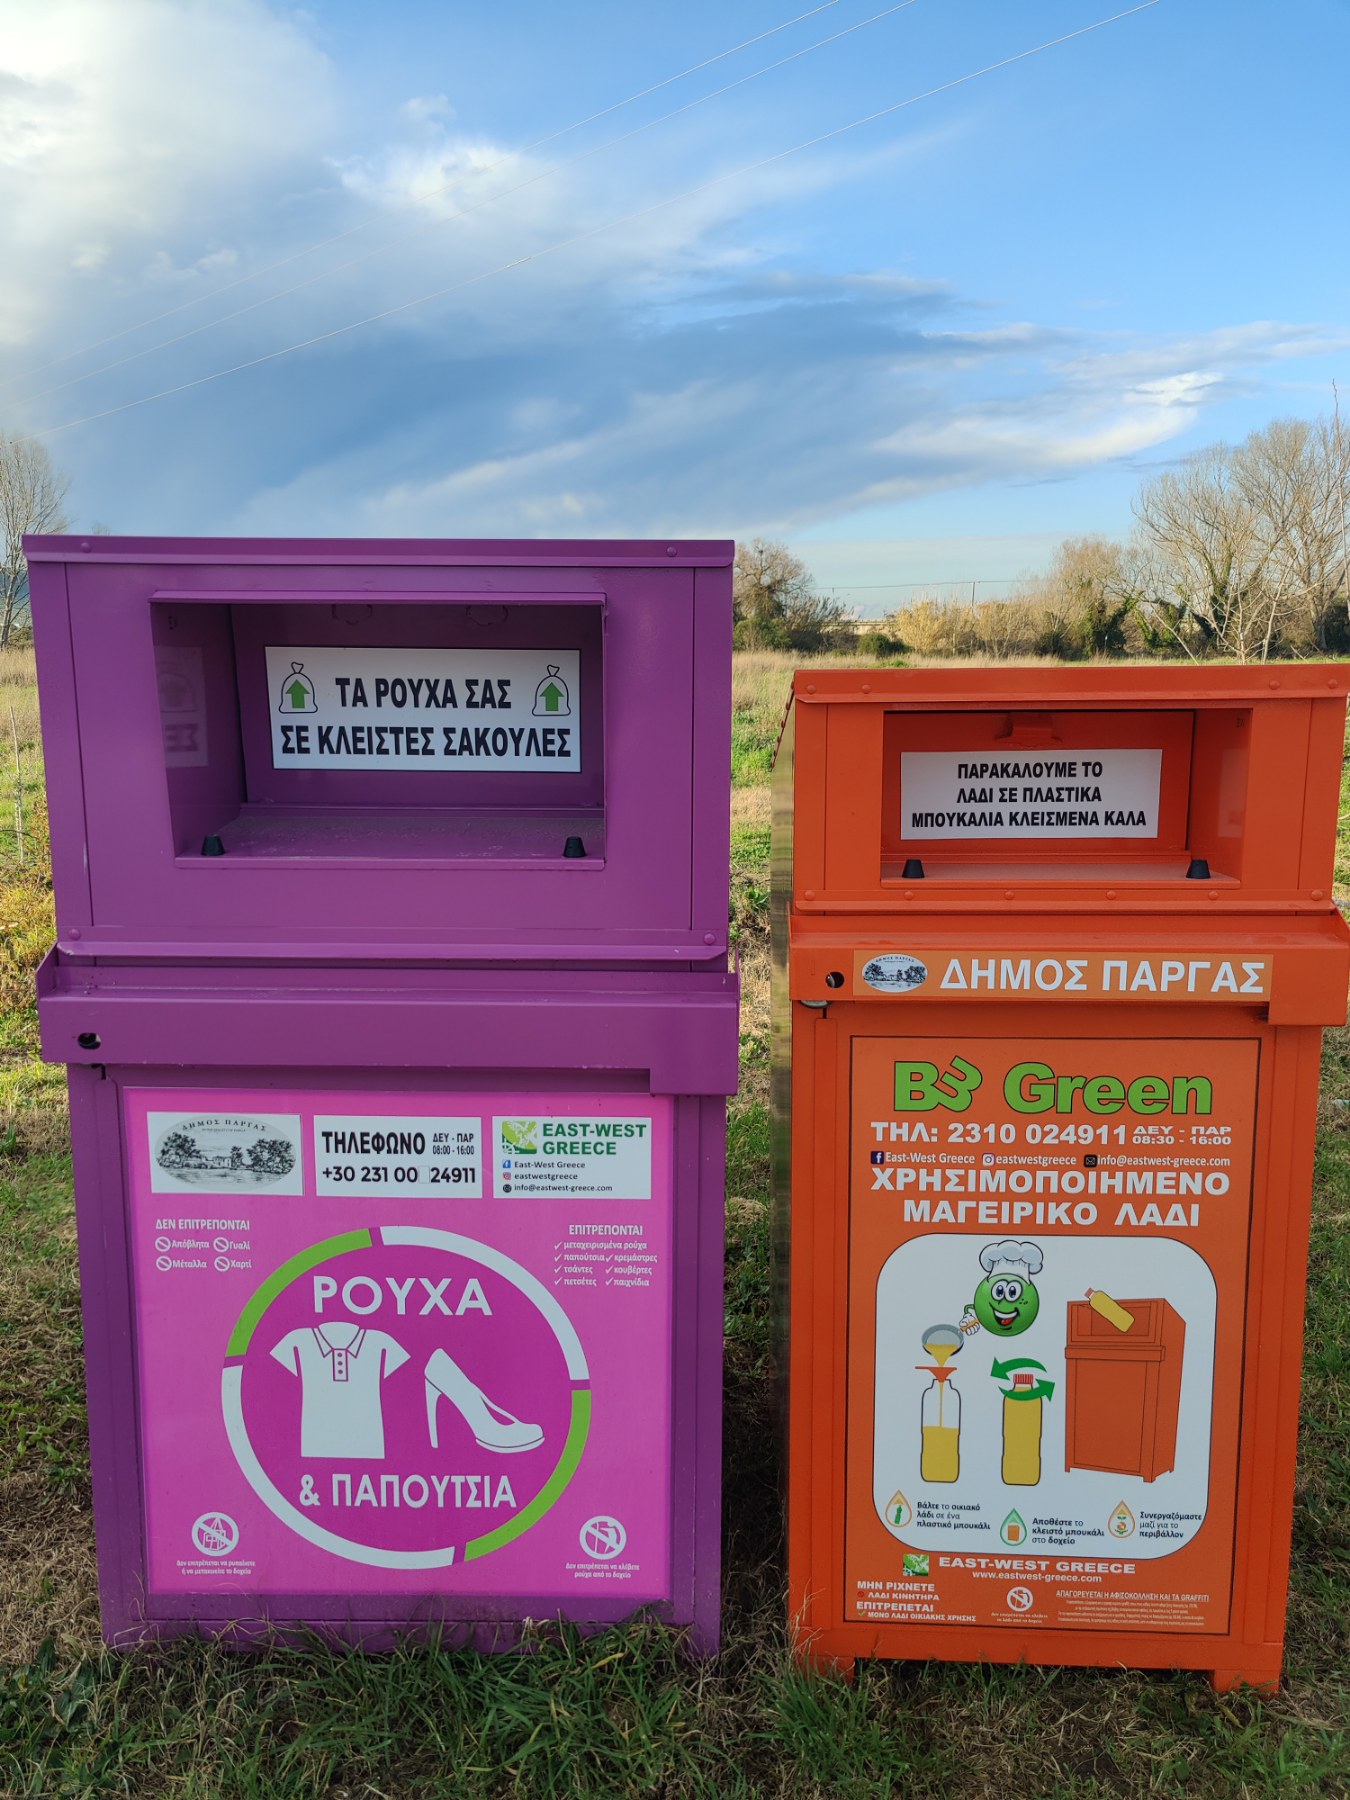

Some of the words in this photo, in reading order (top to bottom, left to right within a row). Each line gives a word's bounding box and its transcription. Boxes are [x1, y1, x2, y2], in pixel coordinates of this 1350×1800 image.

[335, 678, 368, 707] ΤΑ
[375, 678, 458, 708] ΡΟΥΧΑ
[465, 679, 511, 708] ΣΑΣ
[280, 725, 310, 754] ΣΕ
[318, 726, 435, 755] ΚΛΕΙΣΤΕΣ
[443, 727, 571, 757] ΣΑΚΟΥΛΕΣ
[958, 762, 1077, 779] ΠΑΡΑΚΑΛΟΥΜΕ
[1082, 762, 1103, 777] ΤΟ
[956, 788, 993, 803] ΛΑΔΙ
[998, 787, 1017, 802] ΣΕ
[1023, 787, 1102, 802] ΠΛΑΣΤΙΚΑ
[912, 812, 1004, 827] ΜΠΟΥΚΑΛΙΑ
[1009, 811, 1099, 826] ΚΛΕΙΣΜΕΝΑ
[1104, 811, 1146, 825] ΚΑΛΑ
[940, 958, 1088, 991] ΔΗΜΟΣ
[1102, 960, 1265, 993] ΠΑΡΓΑΣ
[1003, 1061, 1213, 1115] Green
[182, 1119, 220, 1131] ΔΗΜΟΣ
[225, 1119, 266, 1131] ΠΑΡΓΑΣ
[542, 1123, 647, 1138] EAST-WEST
[1133, 1126, 1173, 1135] ΔΕΥ
[1191, 1126, 1232, 1135] ΠΑΡ
[433, 1133, 449, 1143] ΔΕΥ
[457, 1133, 474, 1143] ΠΑΡ
[870, 1122, 938, 1142] ΤΗΛ:
[948, 1123, 1016, 1144] 2310
[1025, 1123, 1126, 1145] 024911
[322, 1131, 426, 1155] ΤΗΛΕΦΩΝΟ
[1132, 1136, 1175, 1145] 08:30
[1189, 1136, 1232, 1145] 16:00
[433, 1145, 451, 1155] 08:00
[457, 1145, 475, 1155] 16:00
[543, 1141, 617, 1155] GREECE
[885, 1152, 936, 1163] East-West
[939, 1153, 975, 1164] Greece
[996, 1154, 1077, 1167] eastwestgreece
[1097, 1154, 1231, 1168] info@eastwest-greece.com
[557, 1161, 586, 1169] Greece
[322, 1166, 356, 1182] +30
[361, 1166, 388, 1182] 231
[394, 1167, 418, 1183] 00
[430, 1167, 476, 1183] 24911
[514, 1173, 578, 1181] eastwestgreece
[870, 1168, 1230, 1196] ΧΡΗΣΙΜΟΠΟΙΗΜΕΝΟ
[514, 1184, 613, 1193] info@eastwest-greece.com
[903, 1200, 1098, 1225] ΜΑΓΕΙΡΙΚΟ
[1114, 1203, 1199, 1227] ΛΑΔΙ
[155, 1219, 176, 1229] ΔΕΝ
[179, 1219, 250, 1230] ΕΠΙΤΡΕΠΟΝΤΑΙ
[569, 1225, 643, 1235] ΕΠΙΤΡΕΠΟΝΤΑΙ
[313, 1275, 493, 1315] ΡΟΥΧΑ
[299, 1474, 320, 1506] &
[332, 1474, 517, 1508] ΠΑΠΟΥΤΣΙΑ
[917, 1502, 940, 1510] Βάλτε
[951, 1503, 980, 1511] οικιακό
[917, 1511, 934, 1519] λάδι
[947, 1511, 960, 1520] ένα
[1140, 1511, 1202, 1521] Συνεργαζόμαστε
[916, 1521, 952, 1529] πλαστικό
[954, 1521, 991, 1530] μπουκάλι
[1032, 1518, 1072, 1527] Αποθέστε
[1139, 1521, 1155, 1529] μαζί
[1032, 1527, 1063, 1536] κλειστό
[1065, 1528, 1105, 1537] μπουκάλι
[1139, 1530, 1184, 1539] περιβάλλον
[1048, 1537, 1075, 1545] δοχείο
[939, 1557, 1050, 1571] EAST-WEST
[1056, 1561, 1136, 1574] GREECE
[972, 1571, 1102, 1582] www.eastwest-greece.com
[857, 1581, 883, 1589] ΜΗΝ
[886, 1582, 935, 1592] ΡΙΧΝΕΤΕ
[857, 1601, 934, 1612] ΕΠΙΤΡΕΠΕΤΑΙ
